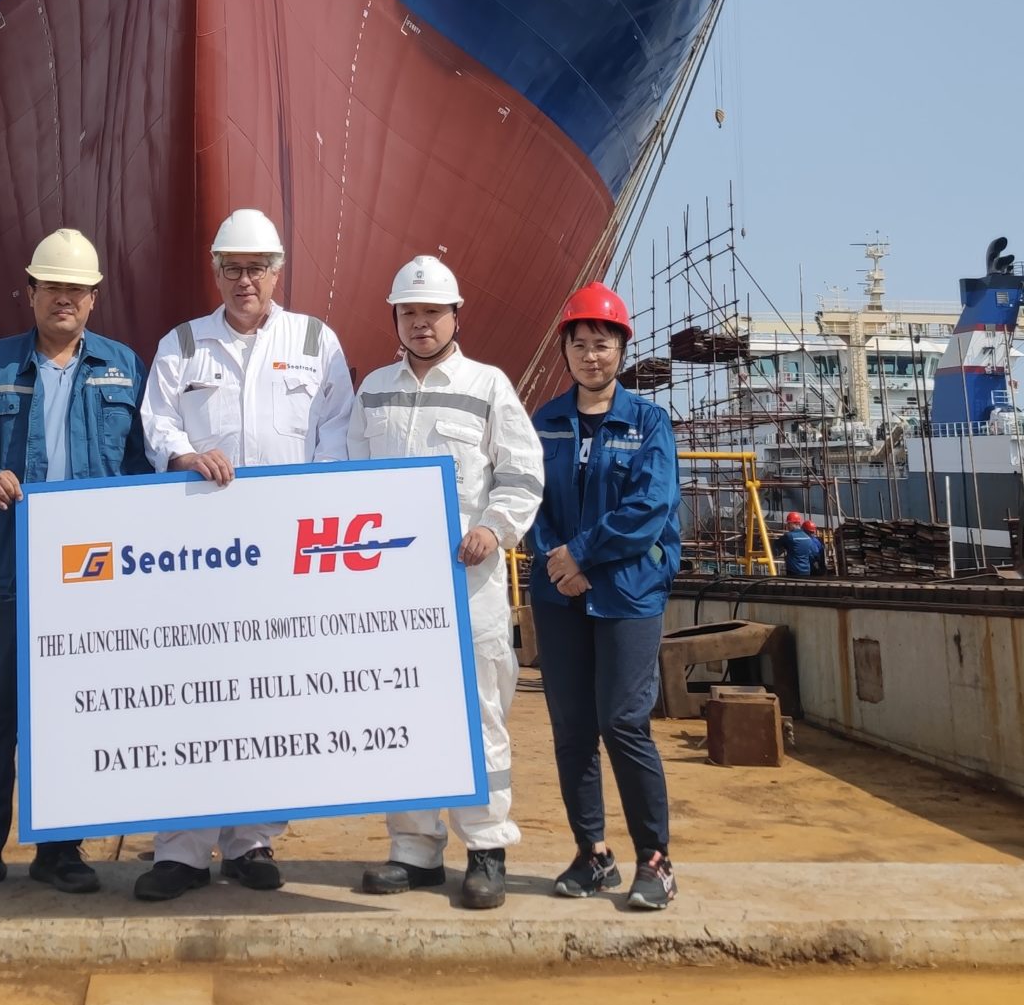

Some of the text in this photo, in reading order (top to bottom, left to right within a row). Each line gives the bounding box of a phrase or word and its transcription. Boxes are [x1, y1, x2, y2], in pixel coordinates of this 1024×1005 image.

[121, 537, 261, 576] Seatrade
[293, 513, 382, 575] HC
[37, 607, 450, 658] THE LAUNCHING CEREMONY FOR 1800TEU CONTAINER VESSEL
[75, 666, 421, 714] SEATRADE CHILE HULL NO. HCY-211
[94, 725, 410, 772] DATE: SEPTEMBER 30, 2023
